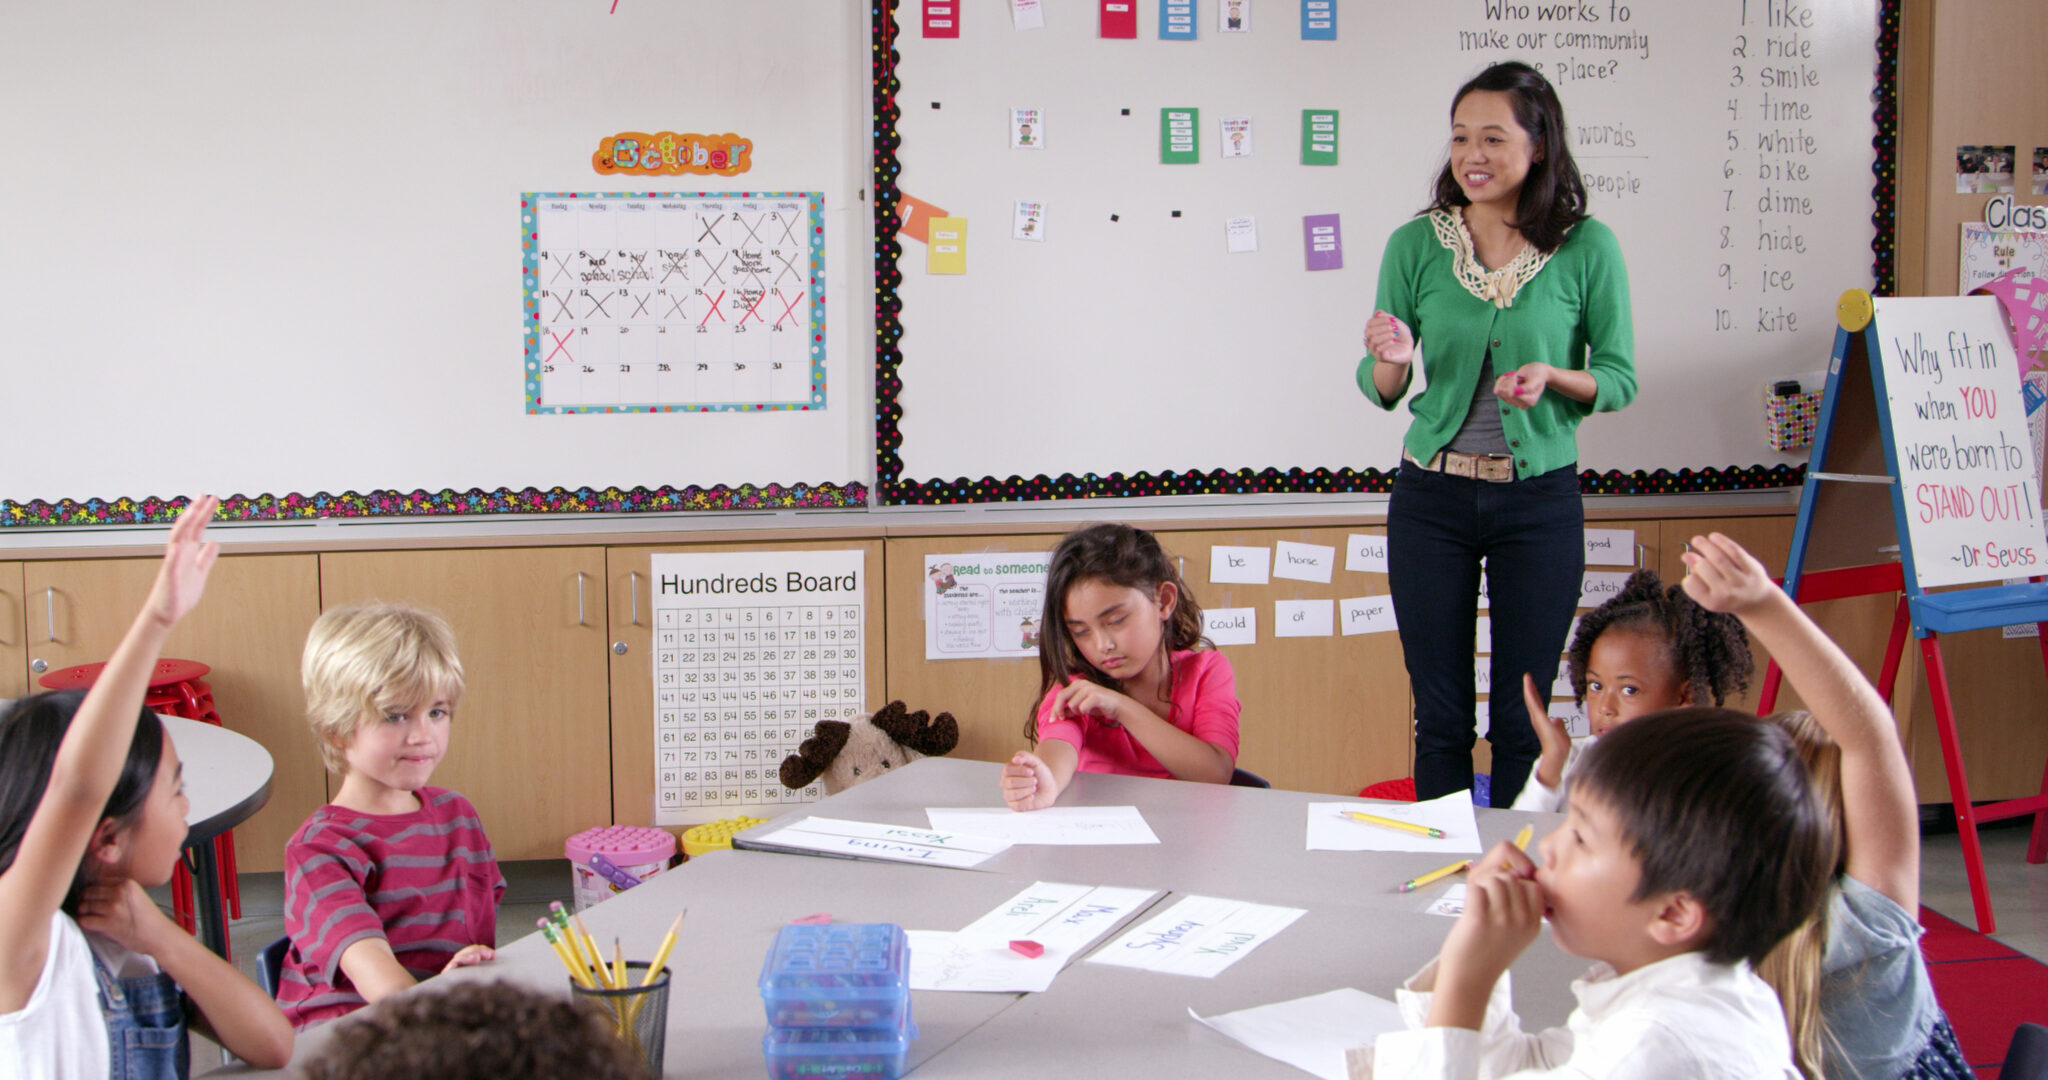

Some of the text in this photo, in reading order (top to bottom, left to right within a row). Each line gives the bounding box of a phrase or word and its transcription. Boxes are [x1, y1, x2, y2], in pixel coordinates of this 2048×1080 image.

[1485, 0, 1631, 23] Who works to
[1768, 0, 1814, 28] like
[1459, 29, 1649, 60] make our community
[1767, 32, 1811, 58] ride
[1557, 56, 1618, 86] place?
[1760, 92, 1812, 121] time
[1577, 122, 1636, 149] words
[1758, 128, 1817, 155] white
[612, 134, 748, 170] October
[1759, 153, 1809, 181] bike
[1582, 170, 1640, 199] people
[1758, 187, 1813, 216] dime
[732, 212, 739, 221] 2
[771, 212, 777, 221] 3
[1758, 219, 1806, 254] hide
[541, 251, 548, 260] 4
[579, 250, 586, 258] 5
[618, 250, 626, 258] 6
[1994, 246, 2015, 257] Rule
[1763, 264, 1794, 293] ice
[1972, 270, 1996, 279] Follow
[542, 290, 549, 298] 11
[619, 288, 628, 297] 13
[657, 288, 666, 296] 14
[695, 288, 703, 296] 15
[771, 288, 778, 296] 17
[1757, 306, 1798, 333] kite
[581, 327, 588, 335] 19
[696, 325, 708, 333] 22
[735, 325, 746, 333] 23
[771, 324, 782, 332] 24
[1895, 331, 1997, 384] Why fit in
[544, 365, 554, 373] 25
[582, 365, 595, 373] 26
[620, 364, 631, 372] 27
[658, 363, 671, 372] 28
[696, 363, 708, 371] 29
[734, 363, 746, 371] 30
[772, 362, 782, 370] 31
[1915, 386, 1996, 420] when YOU
[1905, 430, 2023, 471] were born to
[1916, 483, 1975, 524] STAND
[1586, 537, 1611, 551] good
[1287, 551, 1319, 566] horse
[1360, 546, 1384, 558] old
[1985, 541, 2037, 569] Seuss
[1228, 554, 1246, 568] be
[953, 564, 981, 576] Read
[660, 571, 857, 595] Hundreds Board
[1584, 580, 1620, 593] Catch
[685, 613, 692, 623] 2
[705, 613, 713, 623] 3
[725, 612, 732, 622] 4
[746, 612, 753, 622] 5
[766, 612, 773, 621] 6
[786, 611, 793, 620] 7
[806, 611, 813, 621] 8
[826, 610, 833, 620] 9
[845, 609, 856, 618] 10
[1351, 606, 1384, 623] paper
[1210, 616, 1246, 630] could
[663, 629, 856, 643] 11 12 13 14 15 16 17 18 19 20
[662, 650, 816, 663] 21 22 23 24 25 26 27 28
[1062, 904, 1120, 925] Max
[1125, 920, 1205, 951] Sydney
